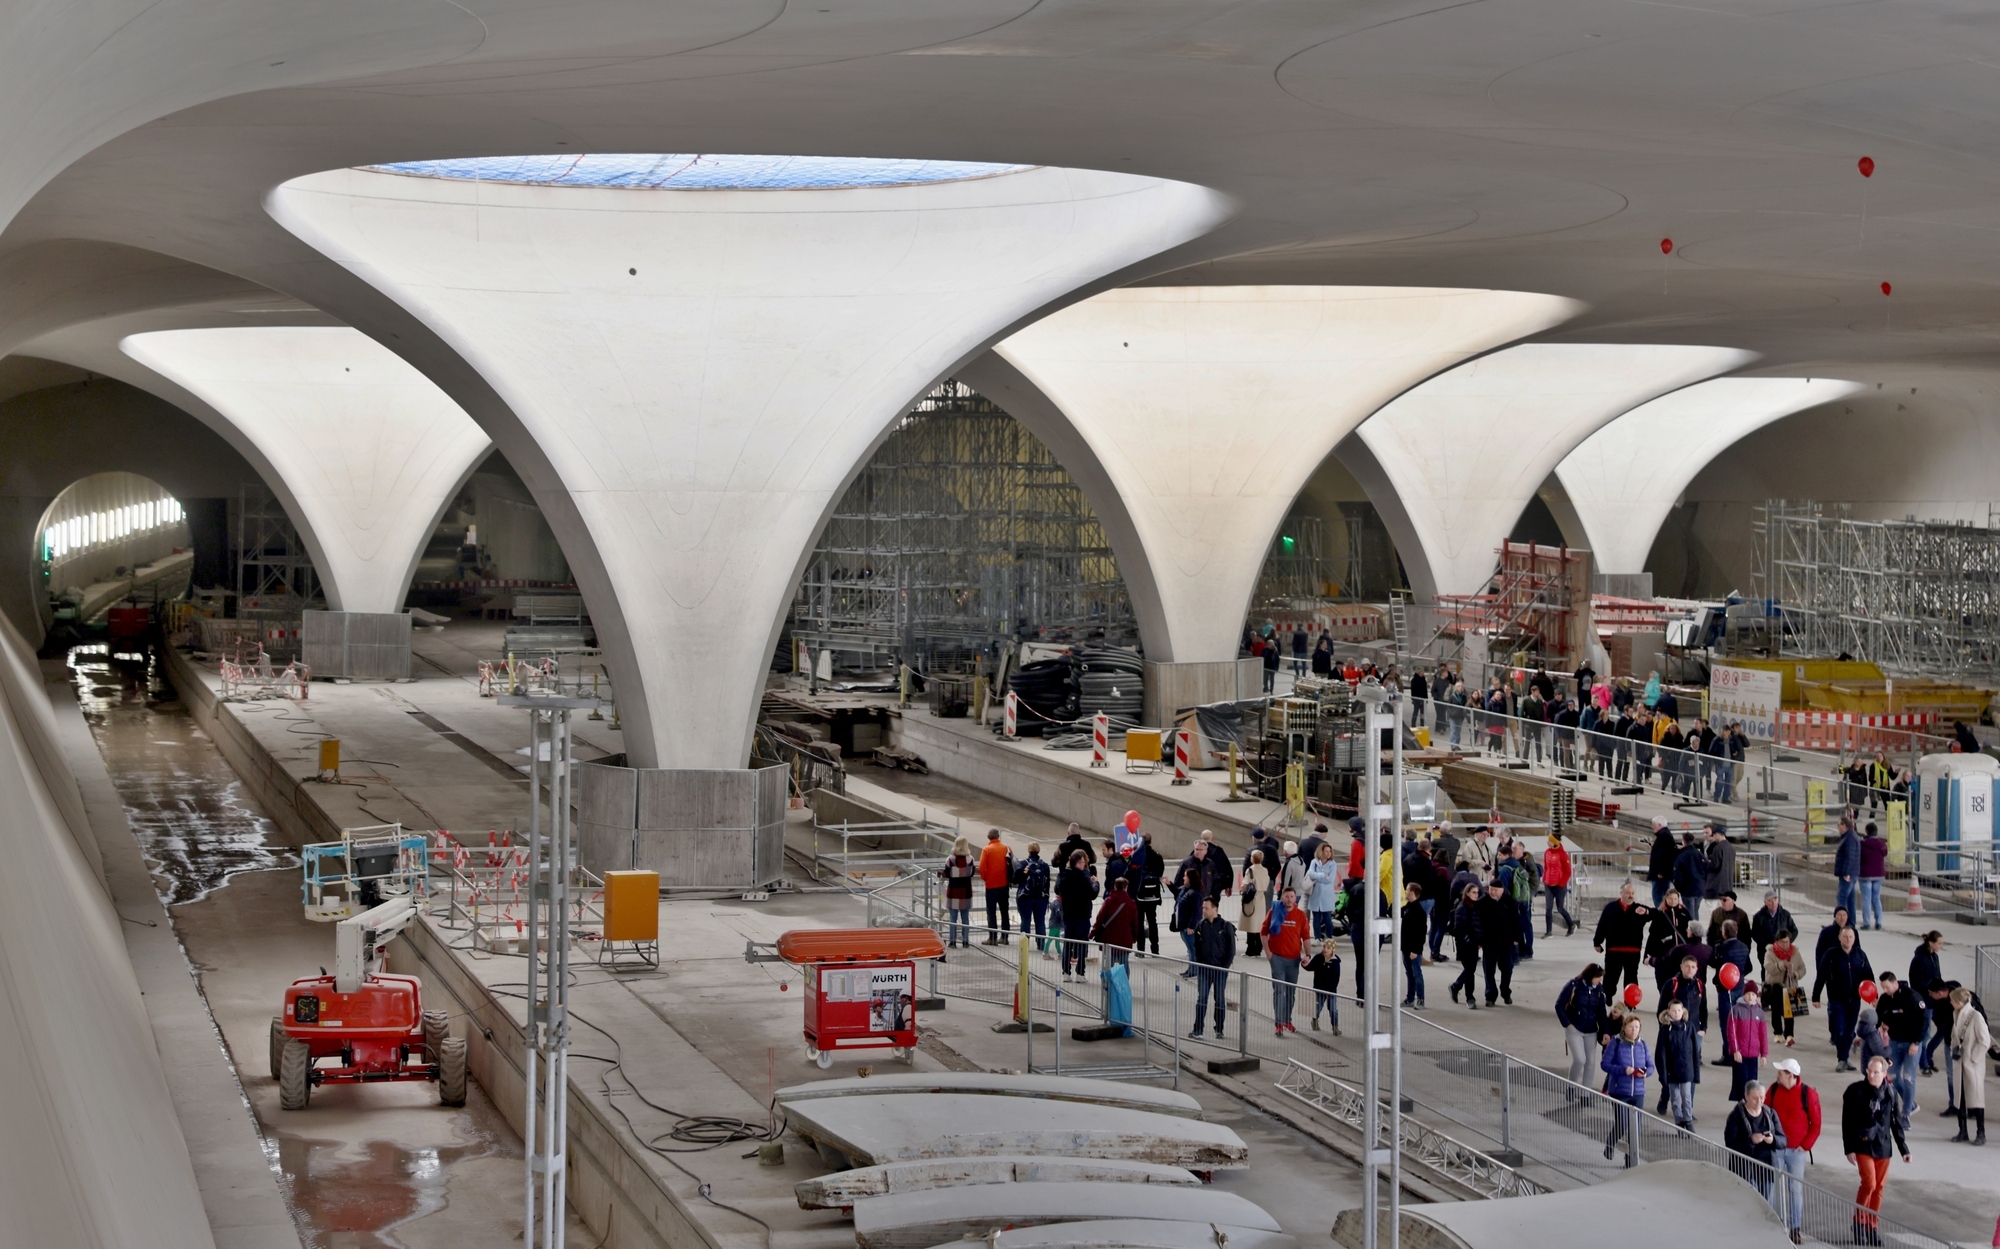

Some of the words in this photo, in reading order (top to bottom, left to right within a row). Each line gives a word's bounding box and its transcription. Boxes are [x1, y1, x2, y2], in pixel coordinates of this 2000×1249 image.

[1972, 804, 1984, 812] TOI
[872, 974, 907, 983] WÜRTH
[329, 1001, 371, 1017] JLG
